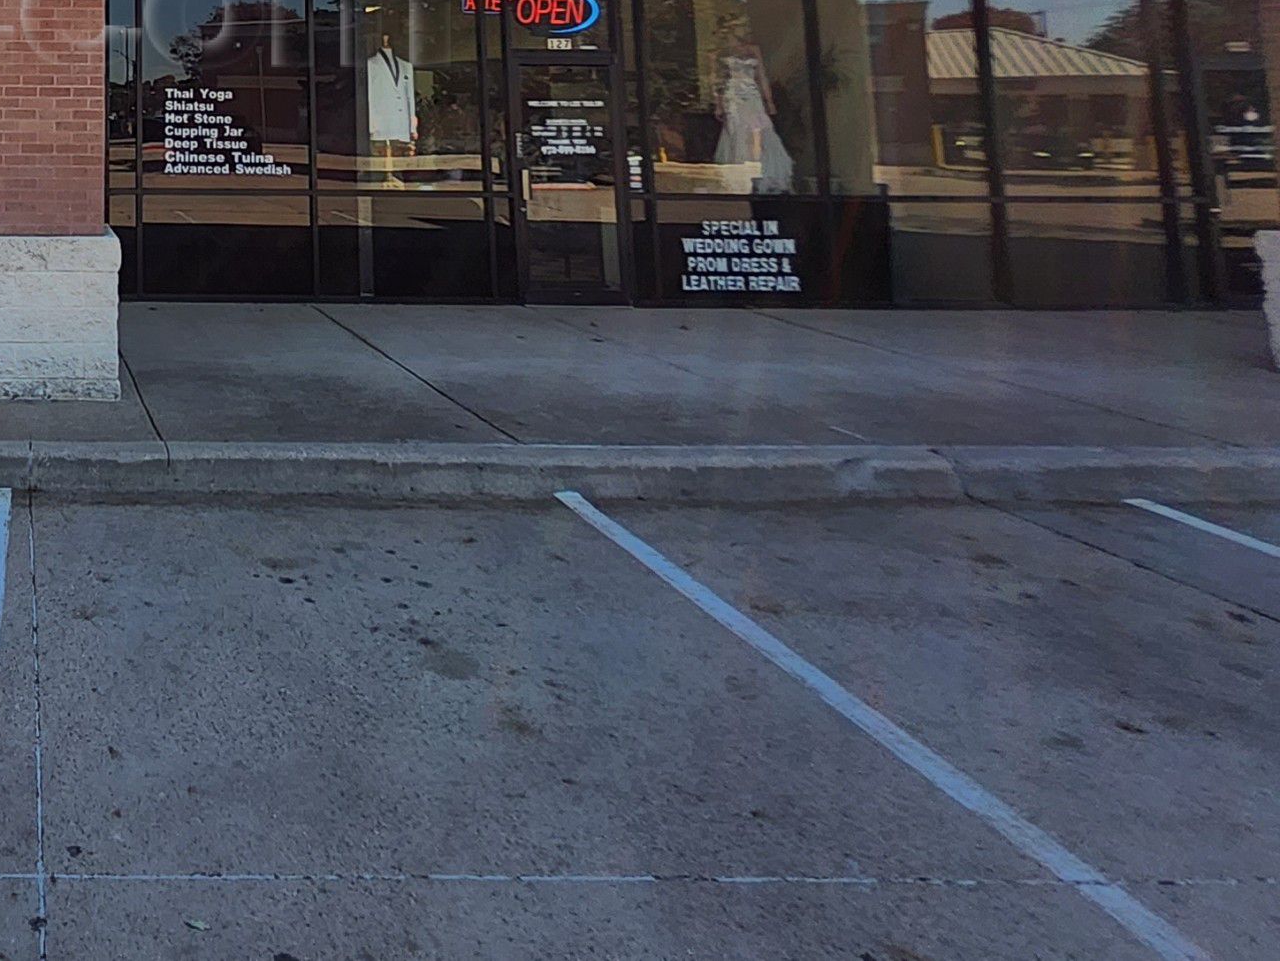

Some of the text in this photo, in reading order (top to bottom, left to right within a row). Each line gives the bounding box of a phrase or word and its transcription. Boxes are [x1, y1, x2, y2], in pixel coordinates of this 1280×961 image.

[549, 39, 570, 49] 127
[164, 88, 234, 102] Thai Yoga
[164, 100, 215, 111] Shiatsu
[164, 113, 233, 124] Hot Stone
[164, 126, 245, 138] Cupping Jar
[164, 138, 248, 151] Deep Tissue
[164, 151, 275, 163] Chinese Tuina
[164, 163, 292, 175] Advanced Swedish
[701, 220, 762, 236] SPECIAL
[681, 238, 797, 254] WEDDING GOWN
[686, 256, 729, 272] PROM
[731, 257, 779, 273] DRESS
[681, 275, 801, 292] LEATHER REPAIR
